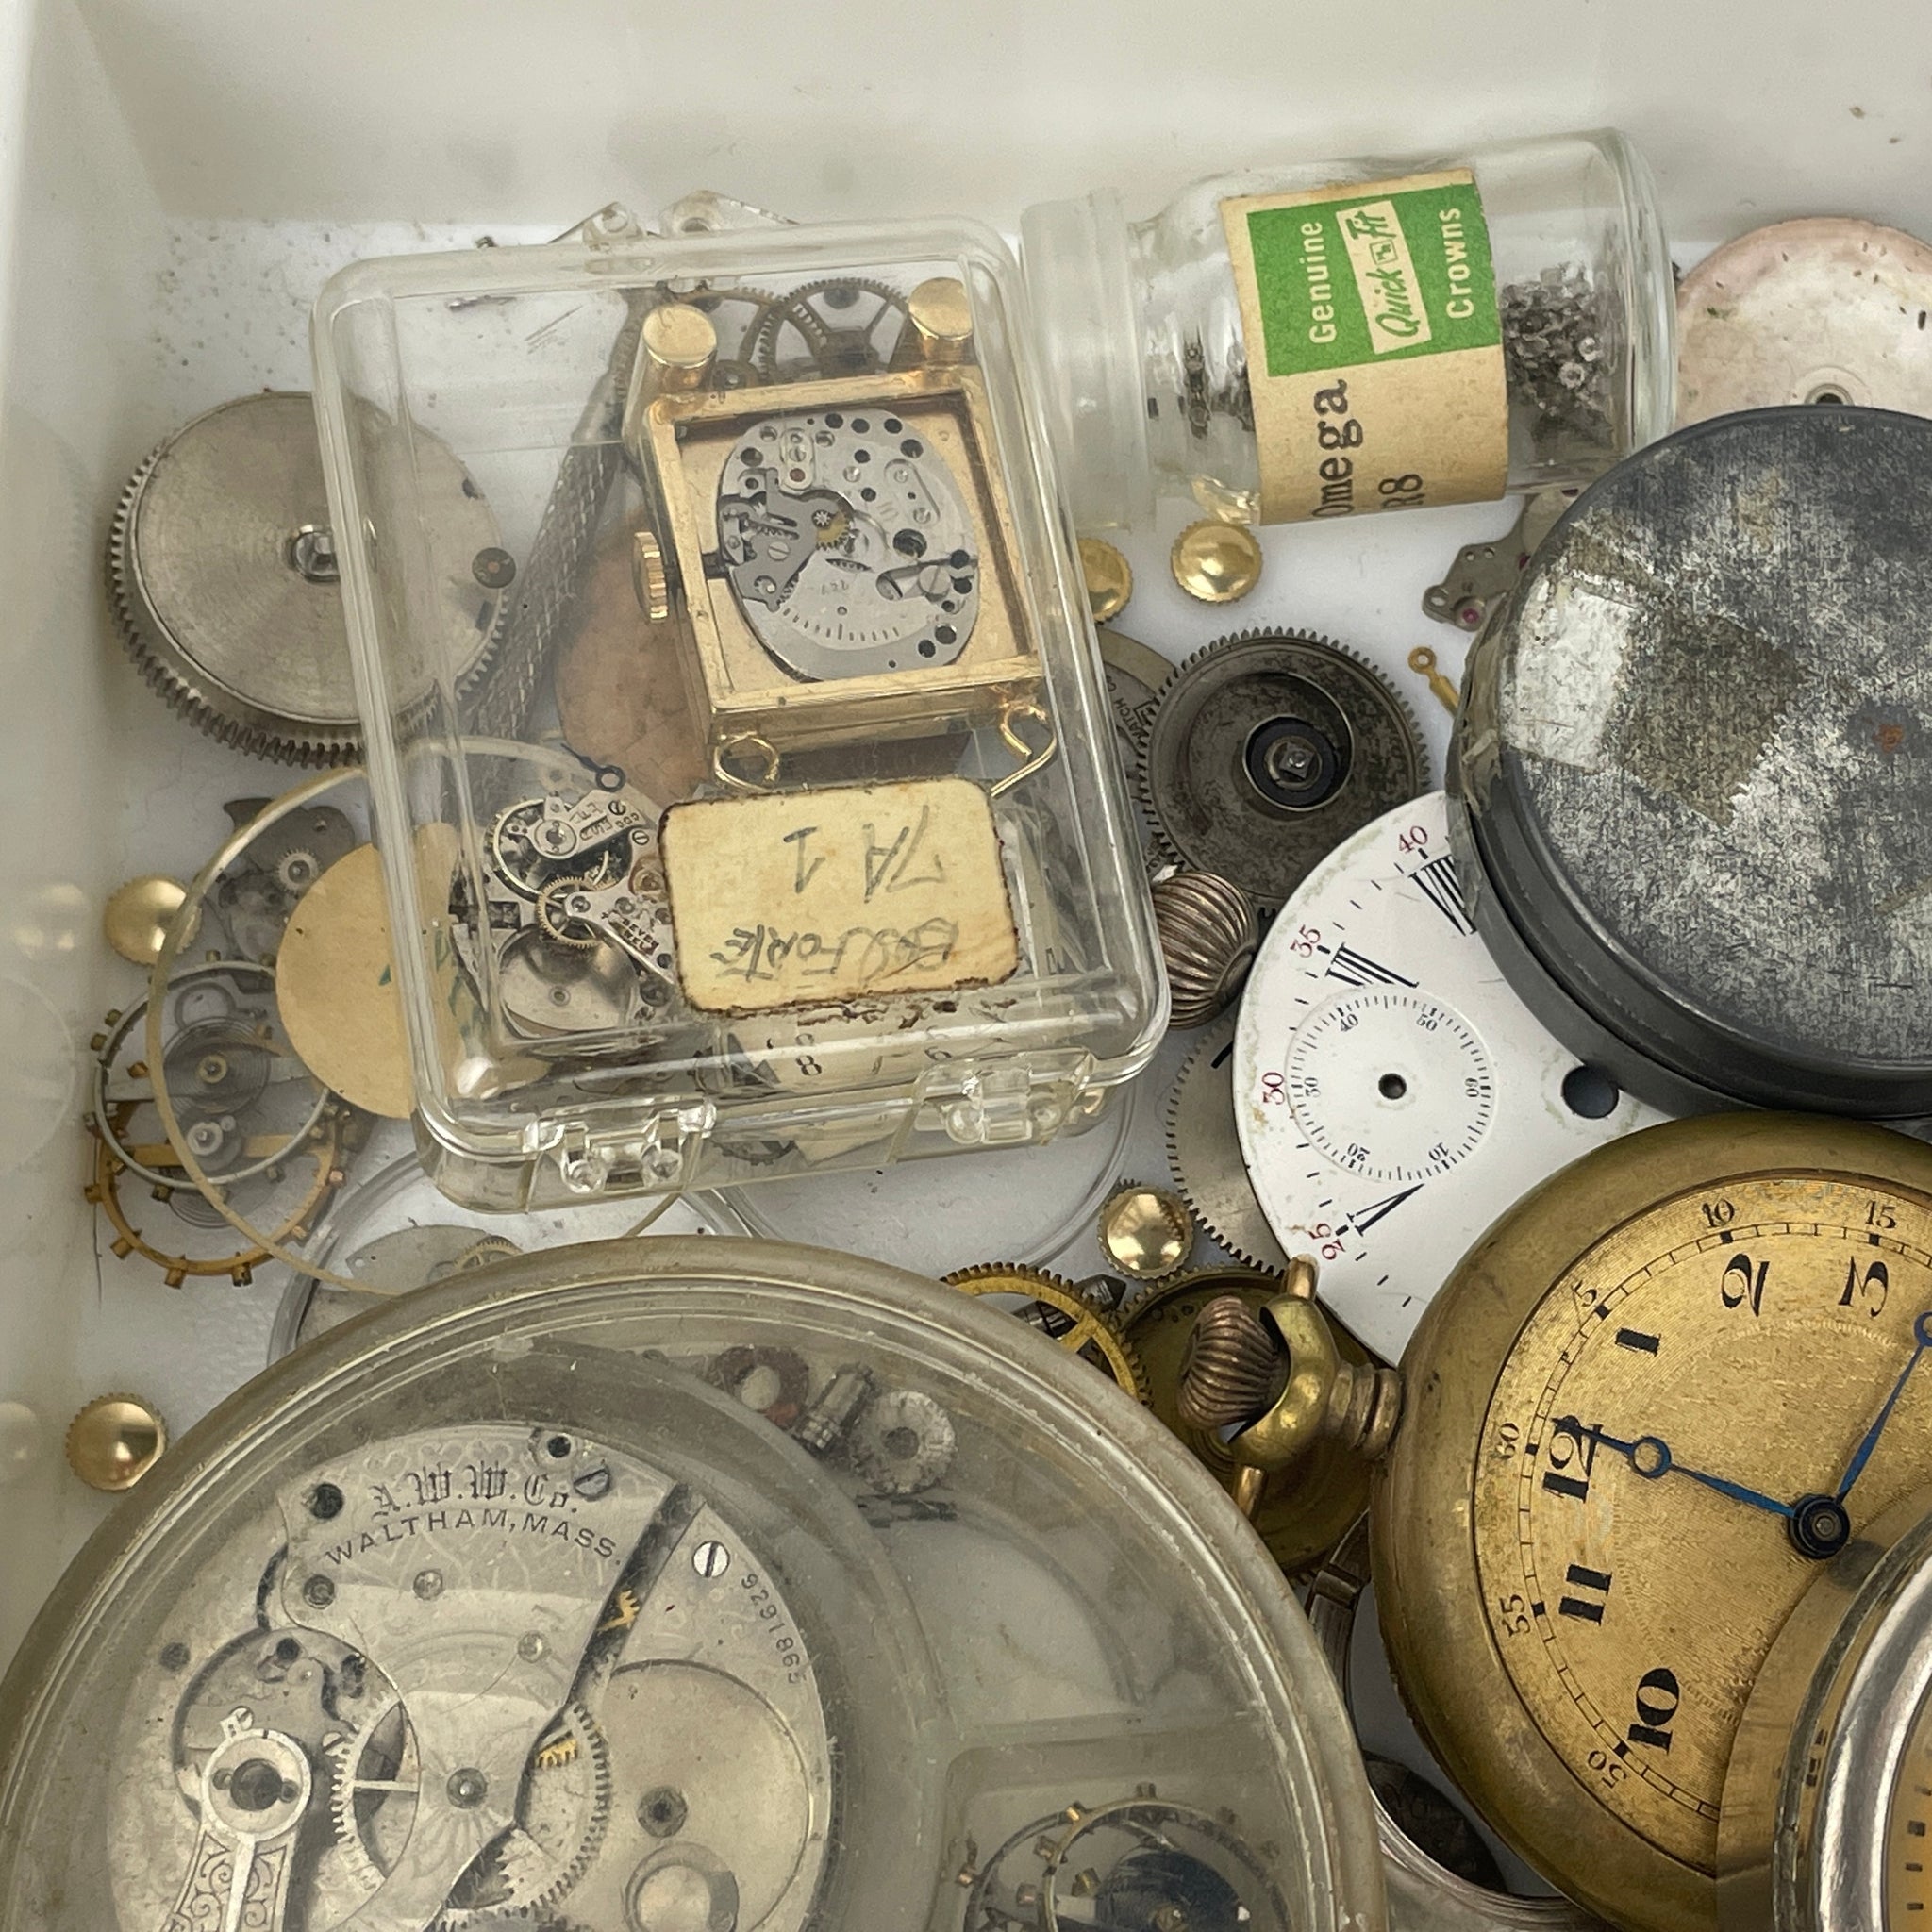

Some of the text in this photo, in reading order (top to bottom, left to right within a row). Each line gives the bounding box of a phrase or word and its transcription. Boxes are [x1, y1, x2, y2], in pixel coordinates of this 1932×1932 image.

[1439, 208, 1474, 319] Crowns
[1299, 222, 1337, 343] Genuine
[1365, 268, 1421, 337] Quick
[1312, 379, 1364, 517] Omega
[1399, 825, 1428, 854] 40
[1290, 924, 1321, 958] 35
[1340, 1013, 1358, 1032] 40
[1416, 1013, 1438, 1031] 50
[1262, 1072, 1285, 1105] 30
[1304, 1077, 1320, 1097] 30
[1347, 1142, 1370, 1161] 20
[1428, 1142, 1449, 1161] 10
[1702, 1198, 1737, 1228] 10
[1864, 1200, 1898, 1229] 15
[1308, 1223, 1346, 1260] 25
[1571, 1280, 1597, 1307] 5
[1721, 1254, 1770, 1316] 2
[1839, 1256, 1889, 1317] 3
[1615, 1327, 1661, 1357] 1
[1496, 1423, 1520, 1459] 60
[1542, 1415, 1604, 1504] 12
[1558, 1563, 1612, 1627] 11
[741, 1574, 808, 1685] 9291865
[1499, 1594, 1531, 1637] 55
[1627, 1667, 1680, 1756] 10
[1588, 1750, 1627, 1789] 50
